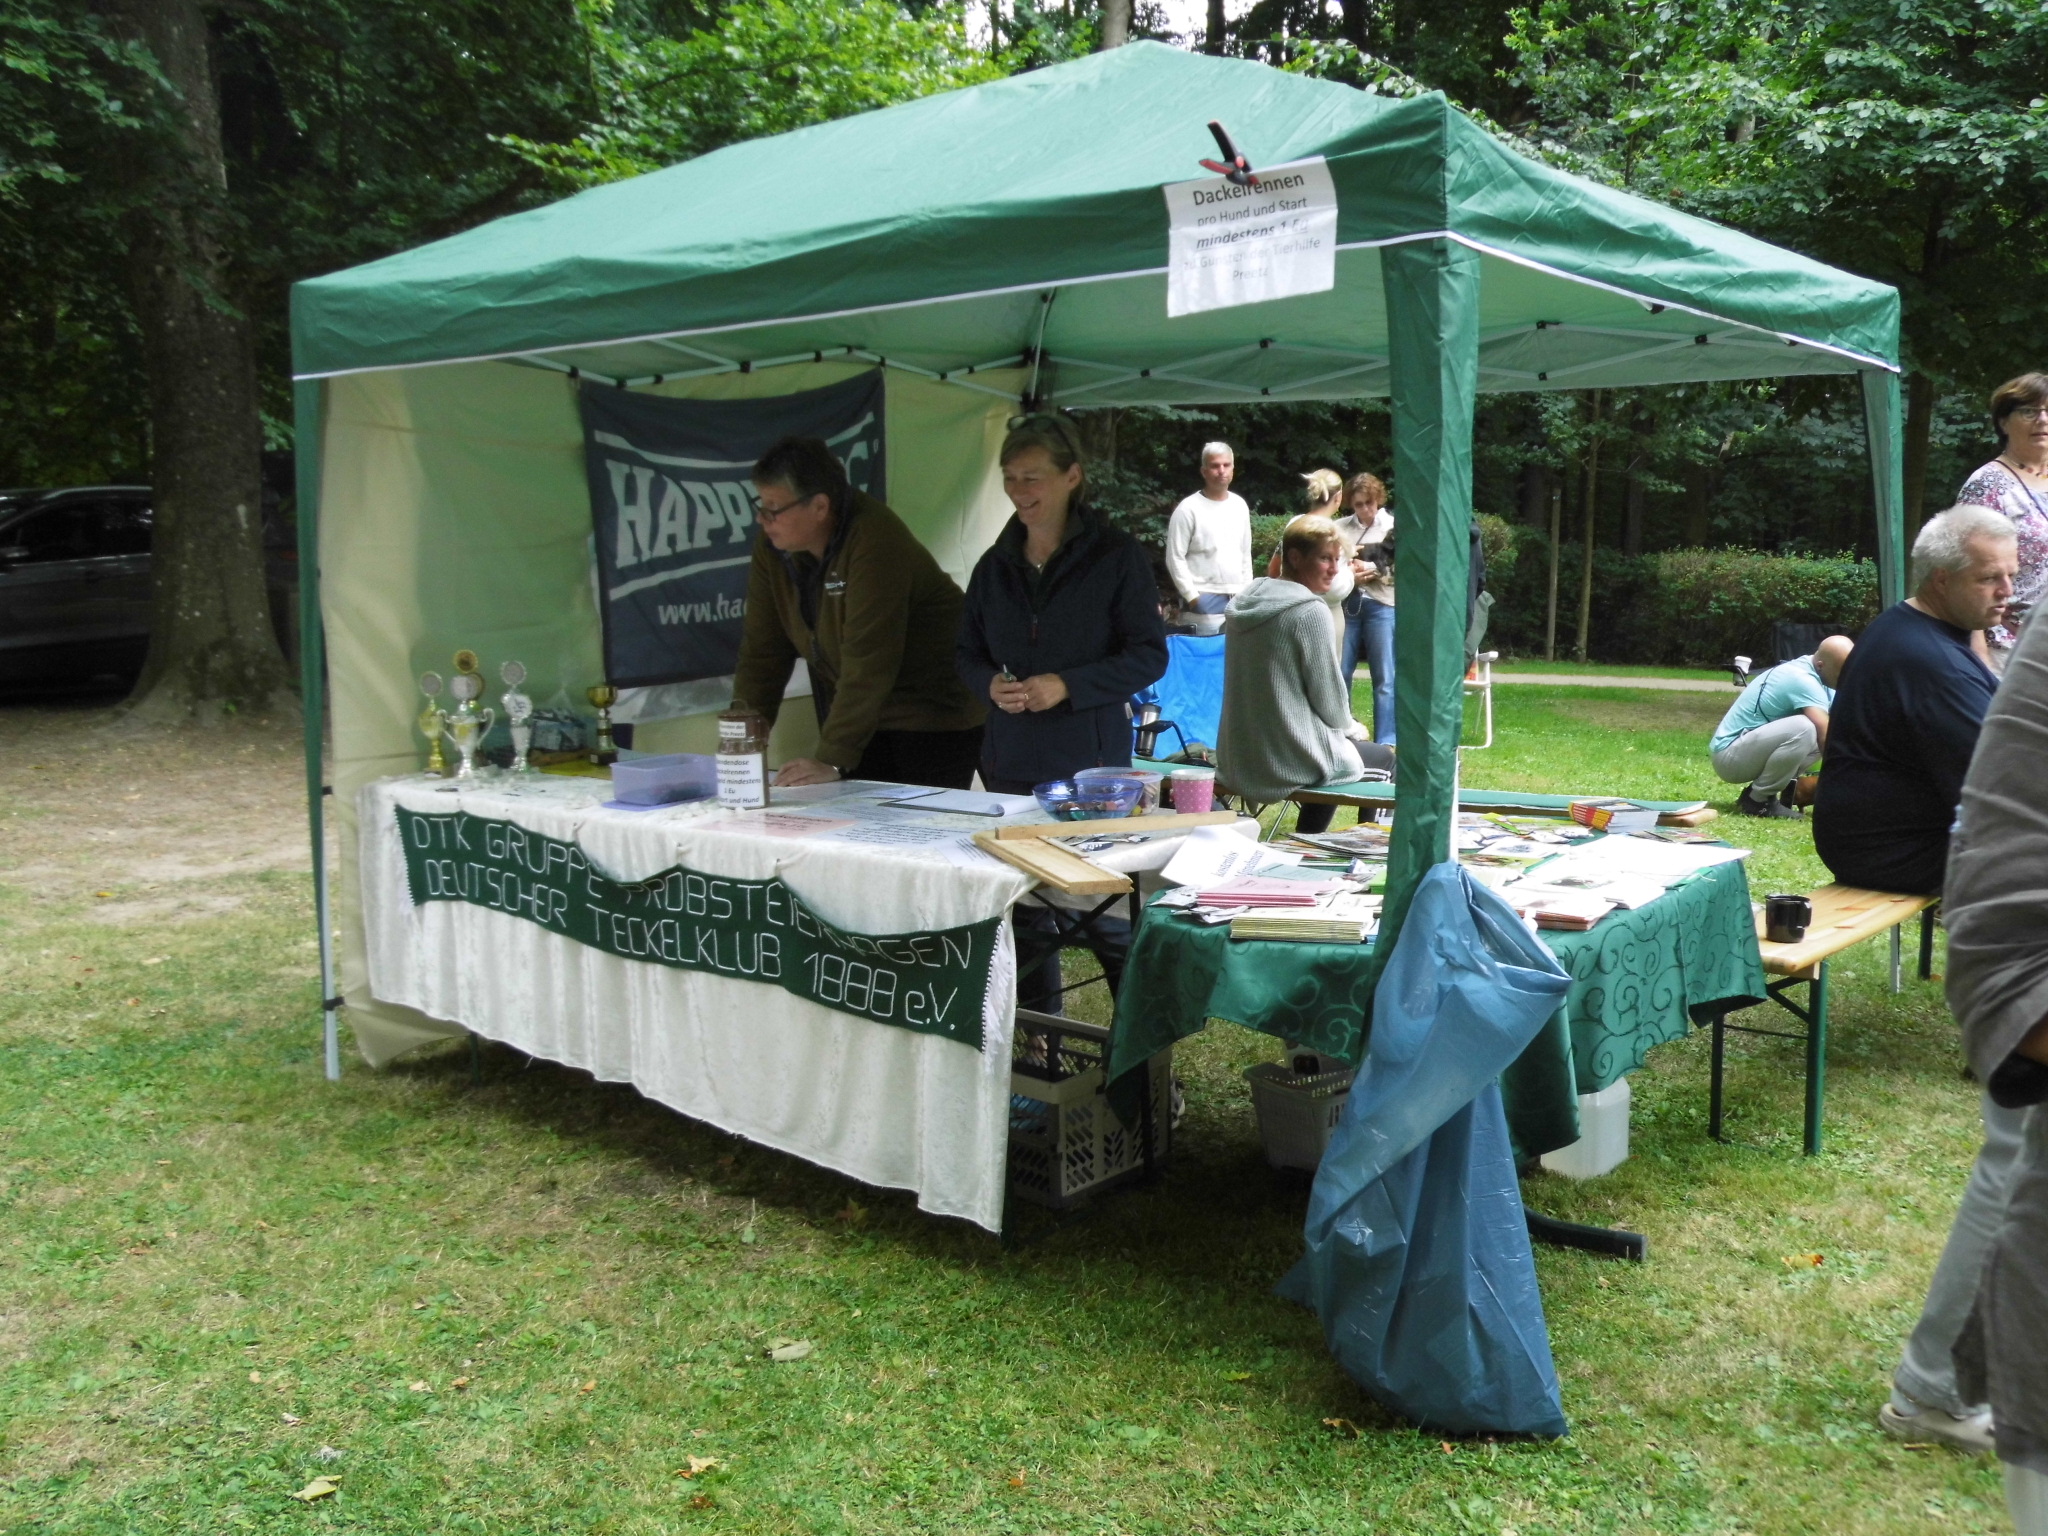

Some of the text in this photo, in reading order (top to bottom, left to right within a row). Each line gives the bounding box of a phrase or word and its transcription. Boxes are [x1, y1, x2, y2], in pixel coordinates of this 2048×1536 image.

[1196, 225, 1275, 249] mindestens
[1197, 197, 1308, 227] pro Hund und Start
[1272, 237, 1321, 255] Tierhilfe
[604, 457, 758, 570] HAPP
[412, 816, 471, 851] DTK
[485, 823, 604, 898] GRUPPE
[425, 859, 569, 928] DEUTSCHER
[803, 951, 898, 1018] 1888
[904, 982, 959, 1031] e.V.
